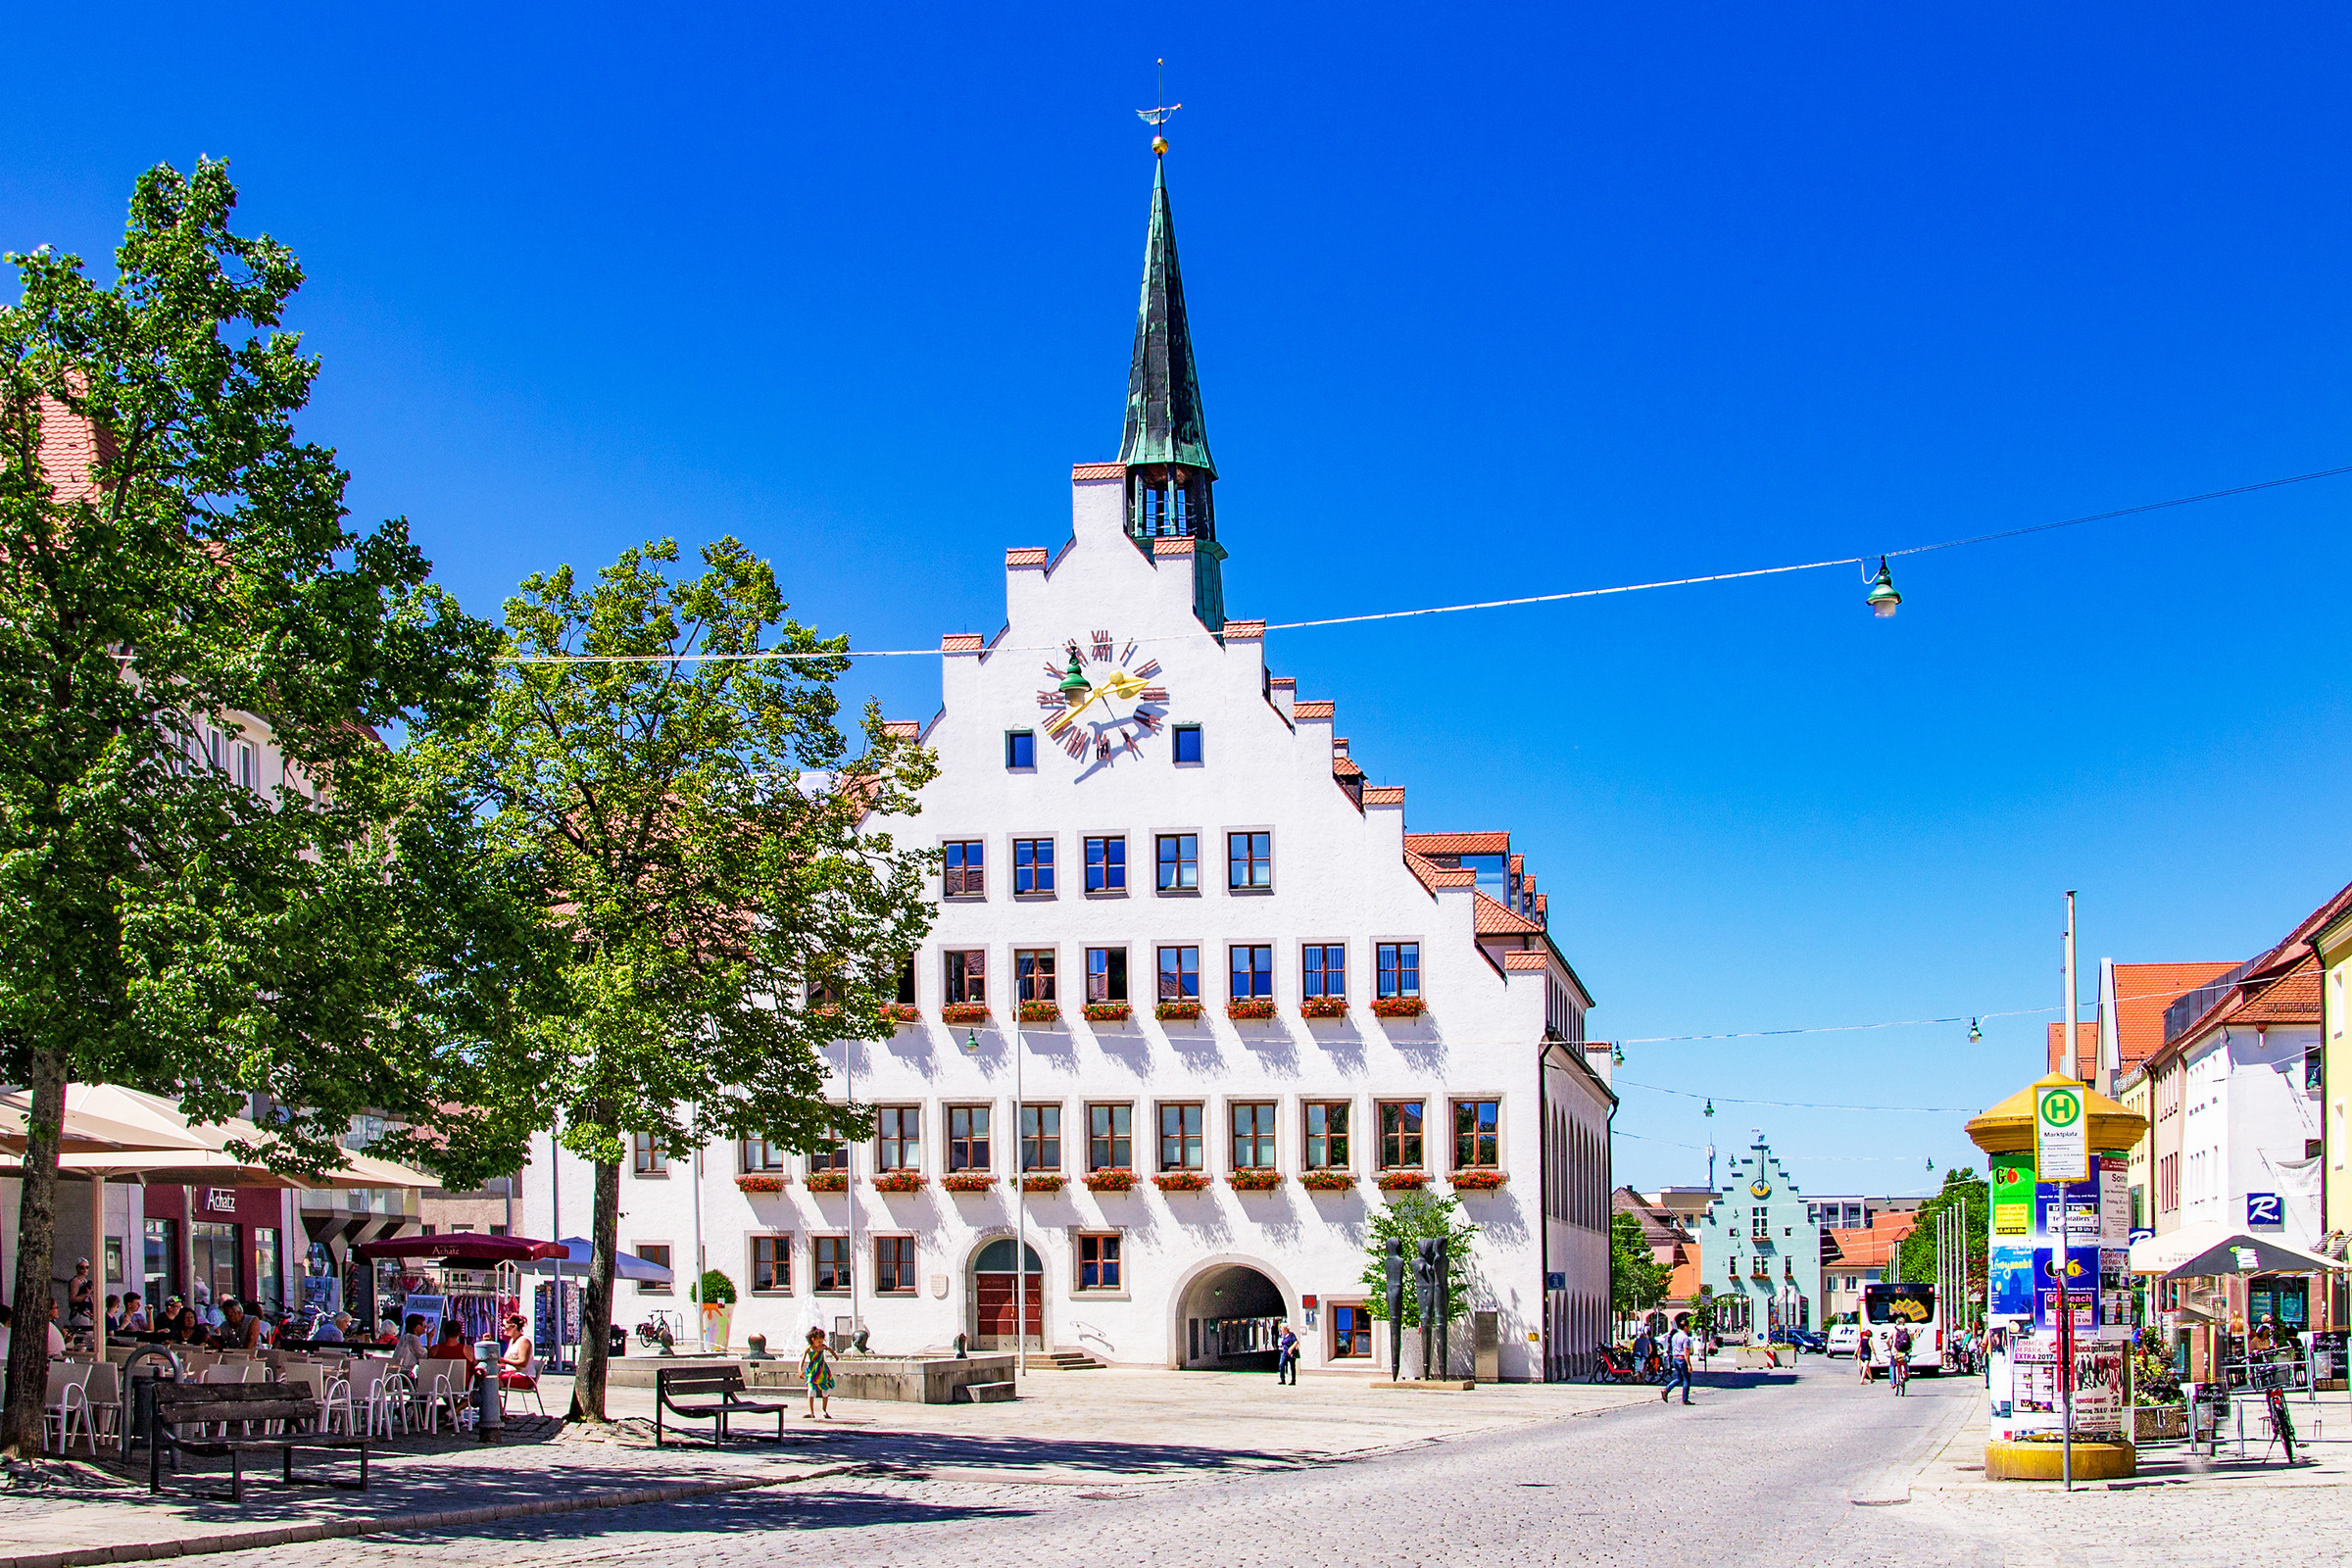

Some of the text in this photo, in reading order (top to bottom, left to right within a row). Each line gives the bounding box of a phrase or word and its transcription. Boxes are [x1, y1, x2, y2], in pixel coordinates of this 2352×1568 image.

[2050, 1098, 2071, 1119] H
[1995, 1166, 2019, 1185] G6
[207, 1187, 235, 1212] Achatz
[432, 1246, 460, 1255] Achatz
